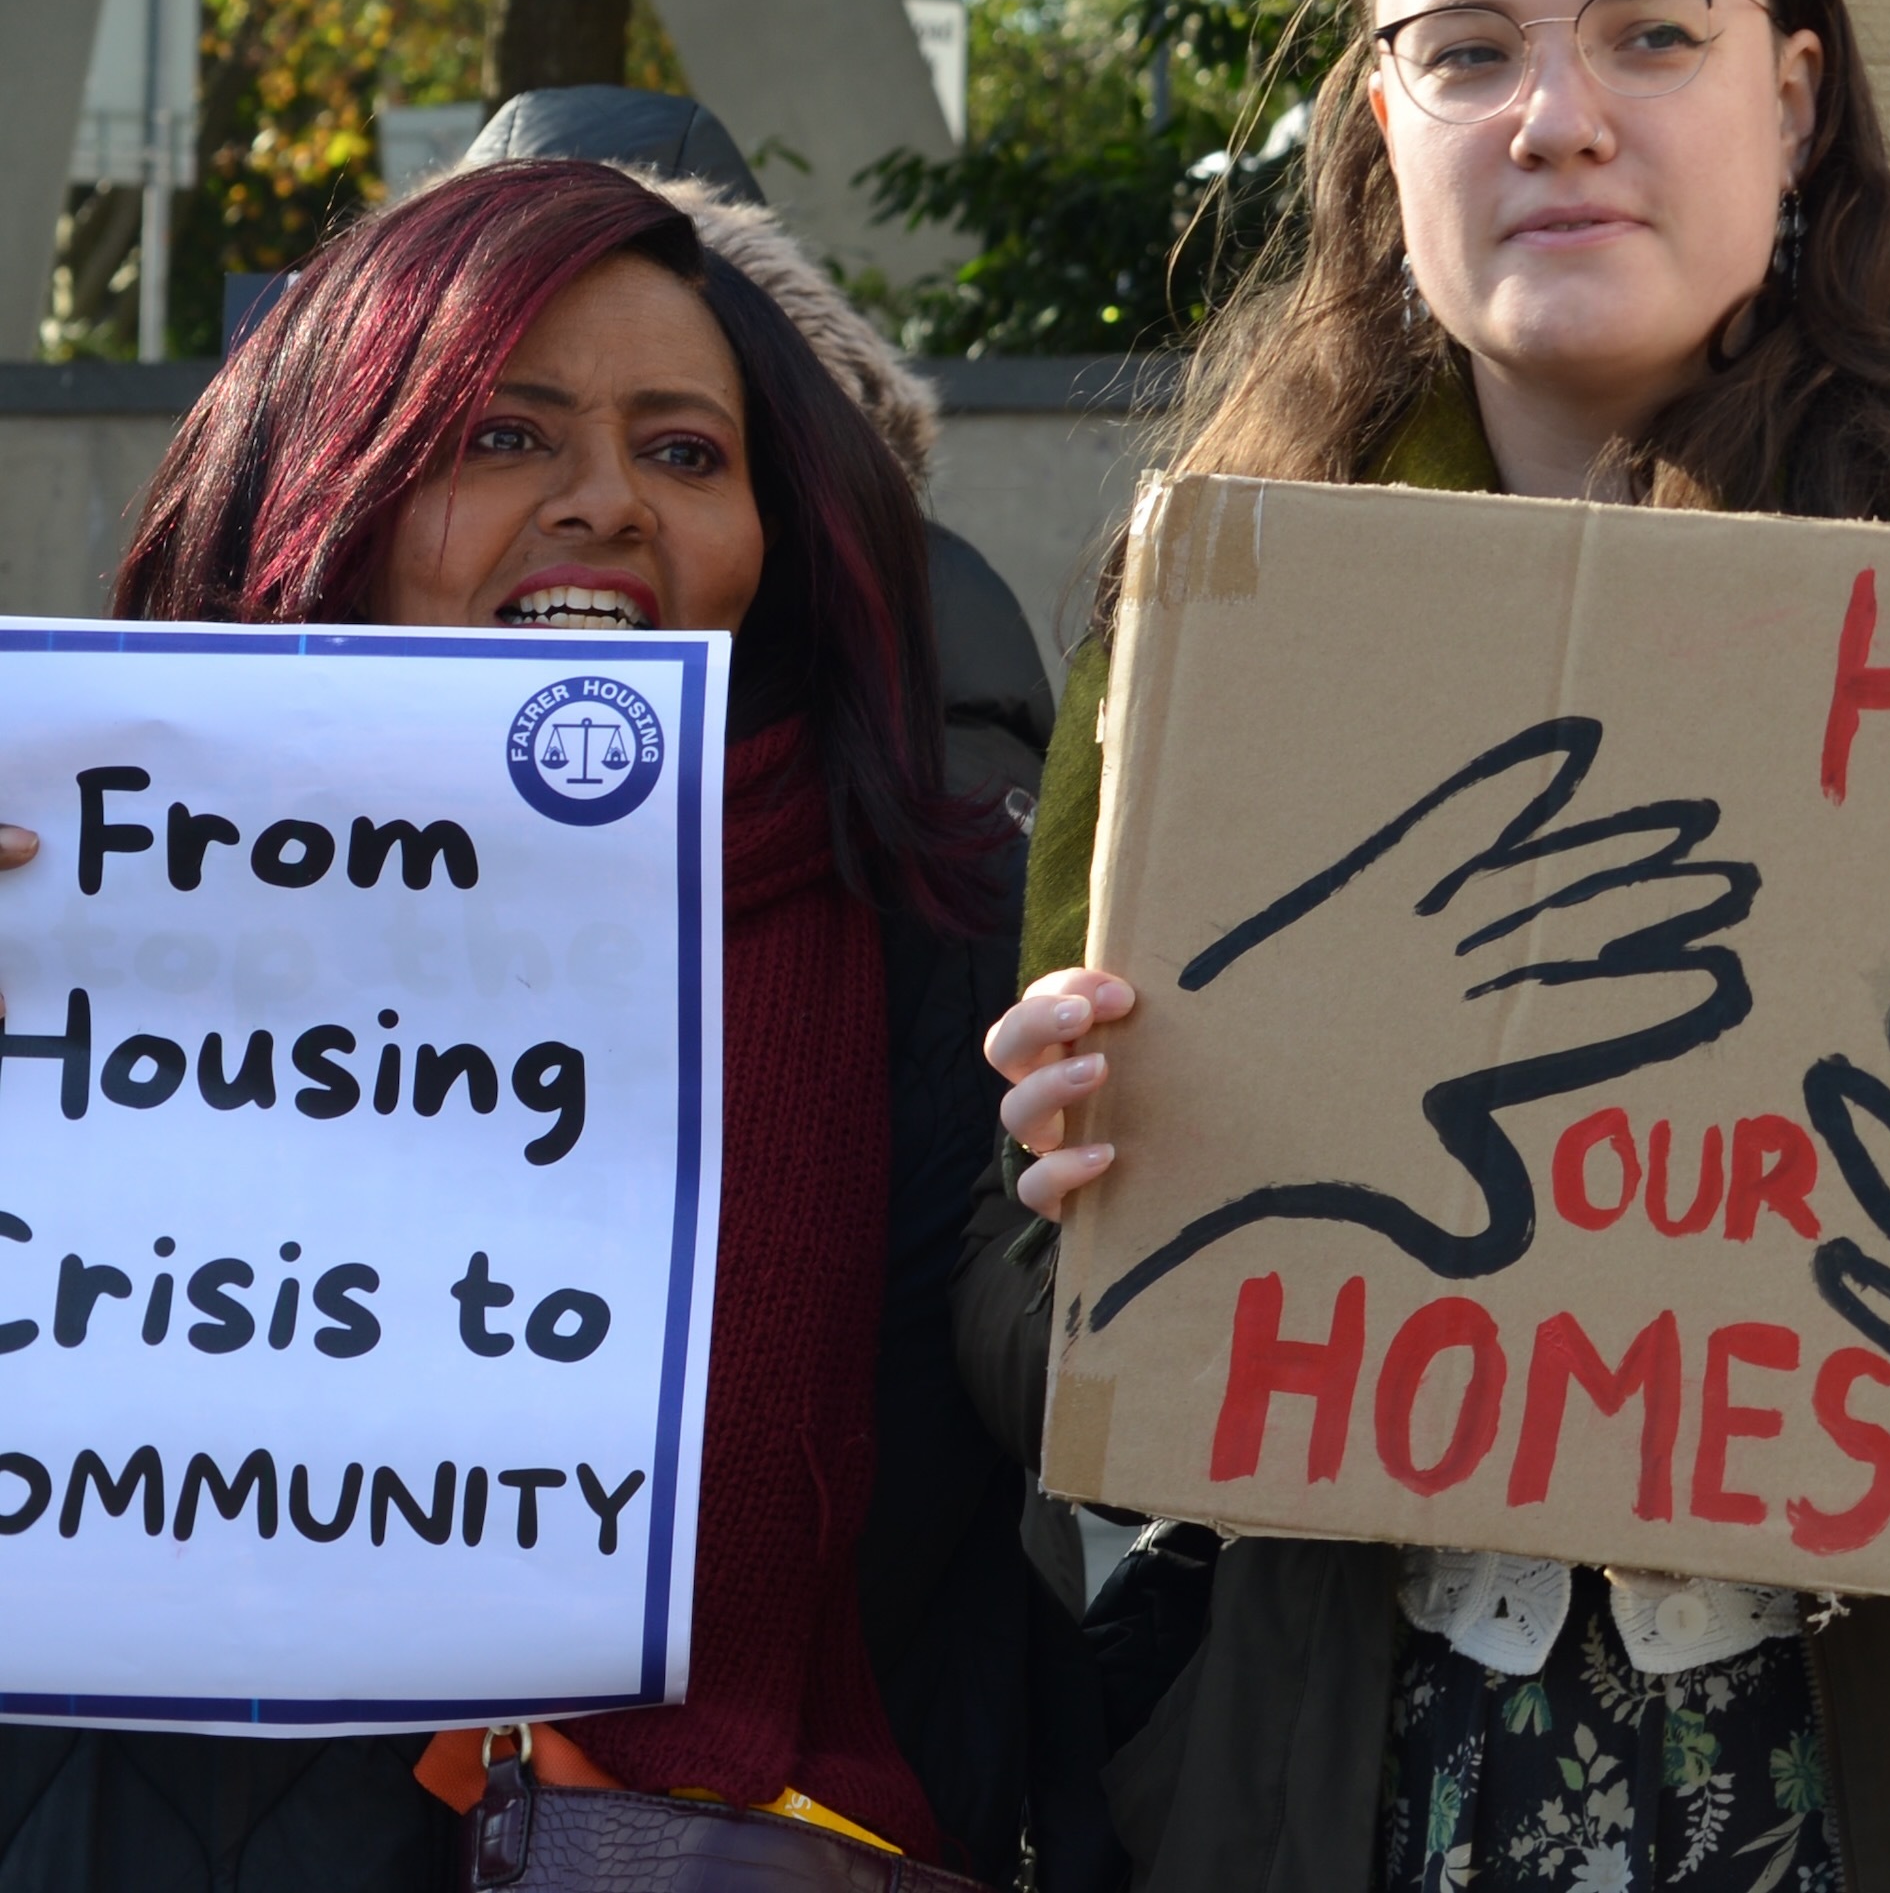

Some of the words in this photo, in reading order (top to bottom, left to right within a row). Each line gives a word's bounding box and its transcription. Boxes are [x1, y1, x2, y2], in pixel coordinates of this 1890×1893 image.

[511, 684, 570, 762] FAIRER
[583, 680, 659, 763] HOUSING
[76, 765, 479, 896] From
[1552, 1107, 1822, 1242] OUR
[452, 1252, 612, 1363] to
[0, 1445, 646, 1556] OMMUNITY
